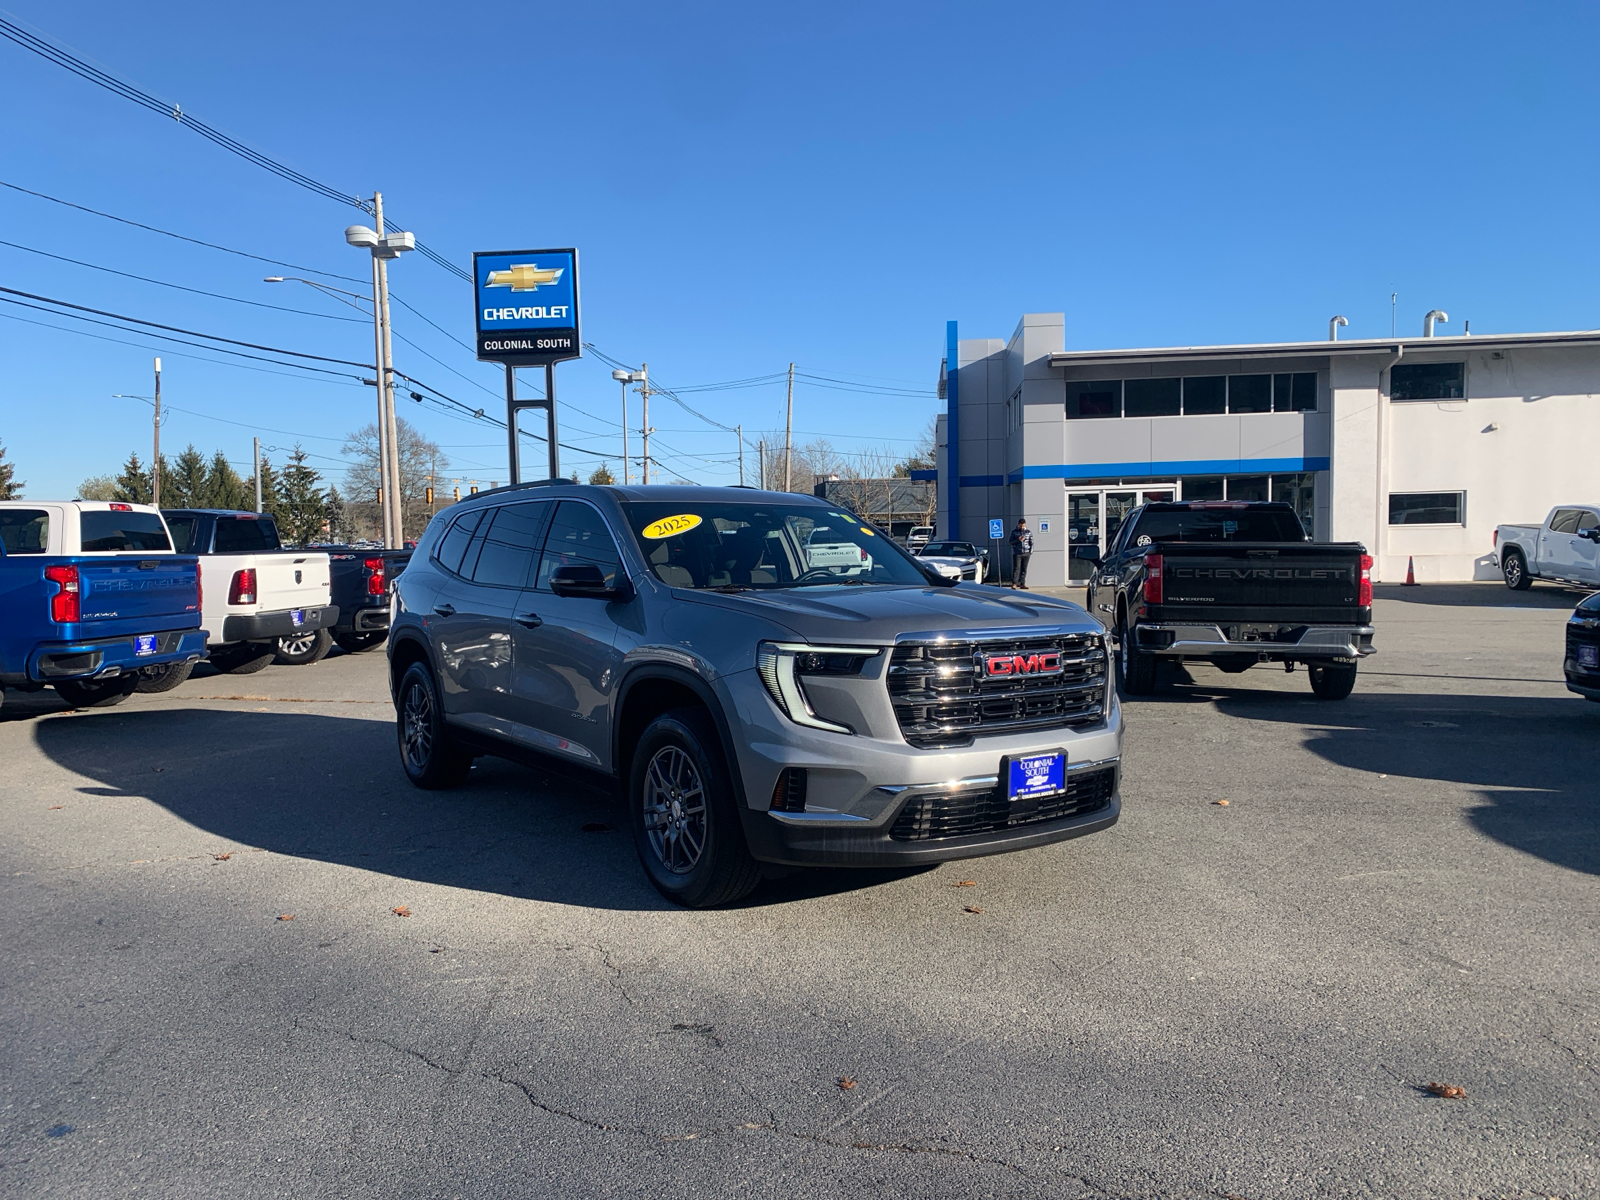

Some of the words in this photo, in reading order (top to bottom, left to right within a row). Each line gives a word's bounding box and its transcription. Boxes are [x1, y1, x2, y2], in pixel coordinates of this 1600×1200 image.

[483, 306, 569, 320] CHEVROLET
[484, 340, 534, 350] COLONIAL
[537, 339, 571, 348] SOUTH
[654, 516, 690, 536] 2025
[1176, 568, 1346, 579] CHEVROLET
[93, 578, 197, 592] CHEVROLET
[988, 653, 1061, 675] GMC
[1020, 758, 1055, 770] COLONIAL
[1025, 766, 1049, 777] SOUTH
